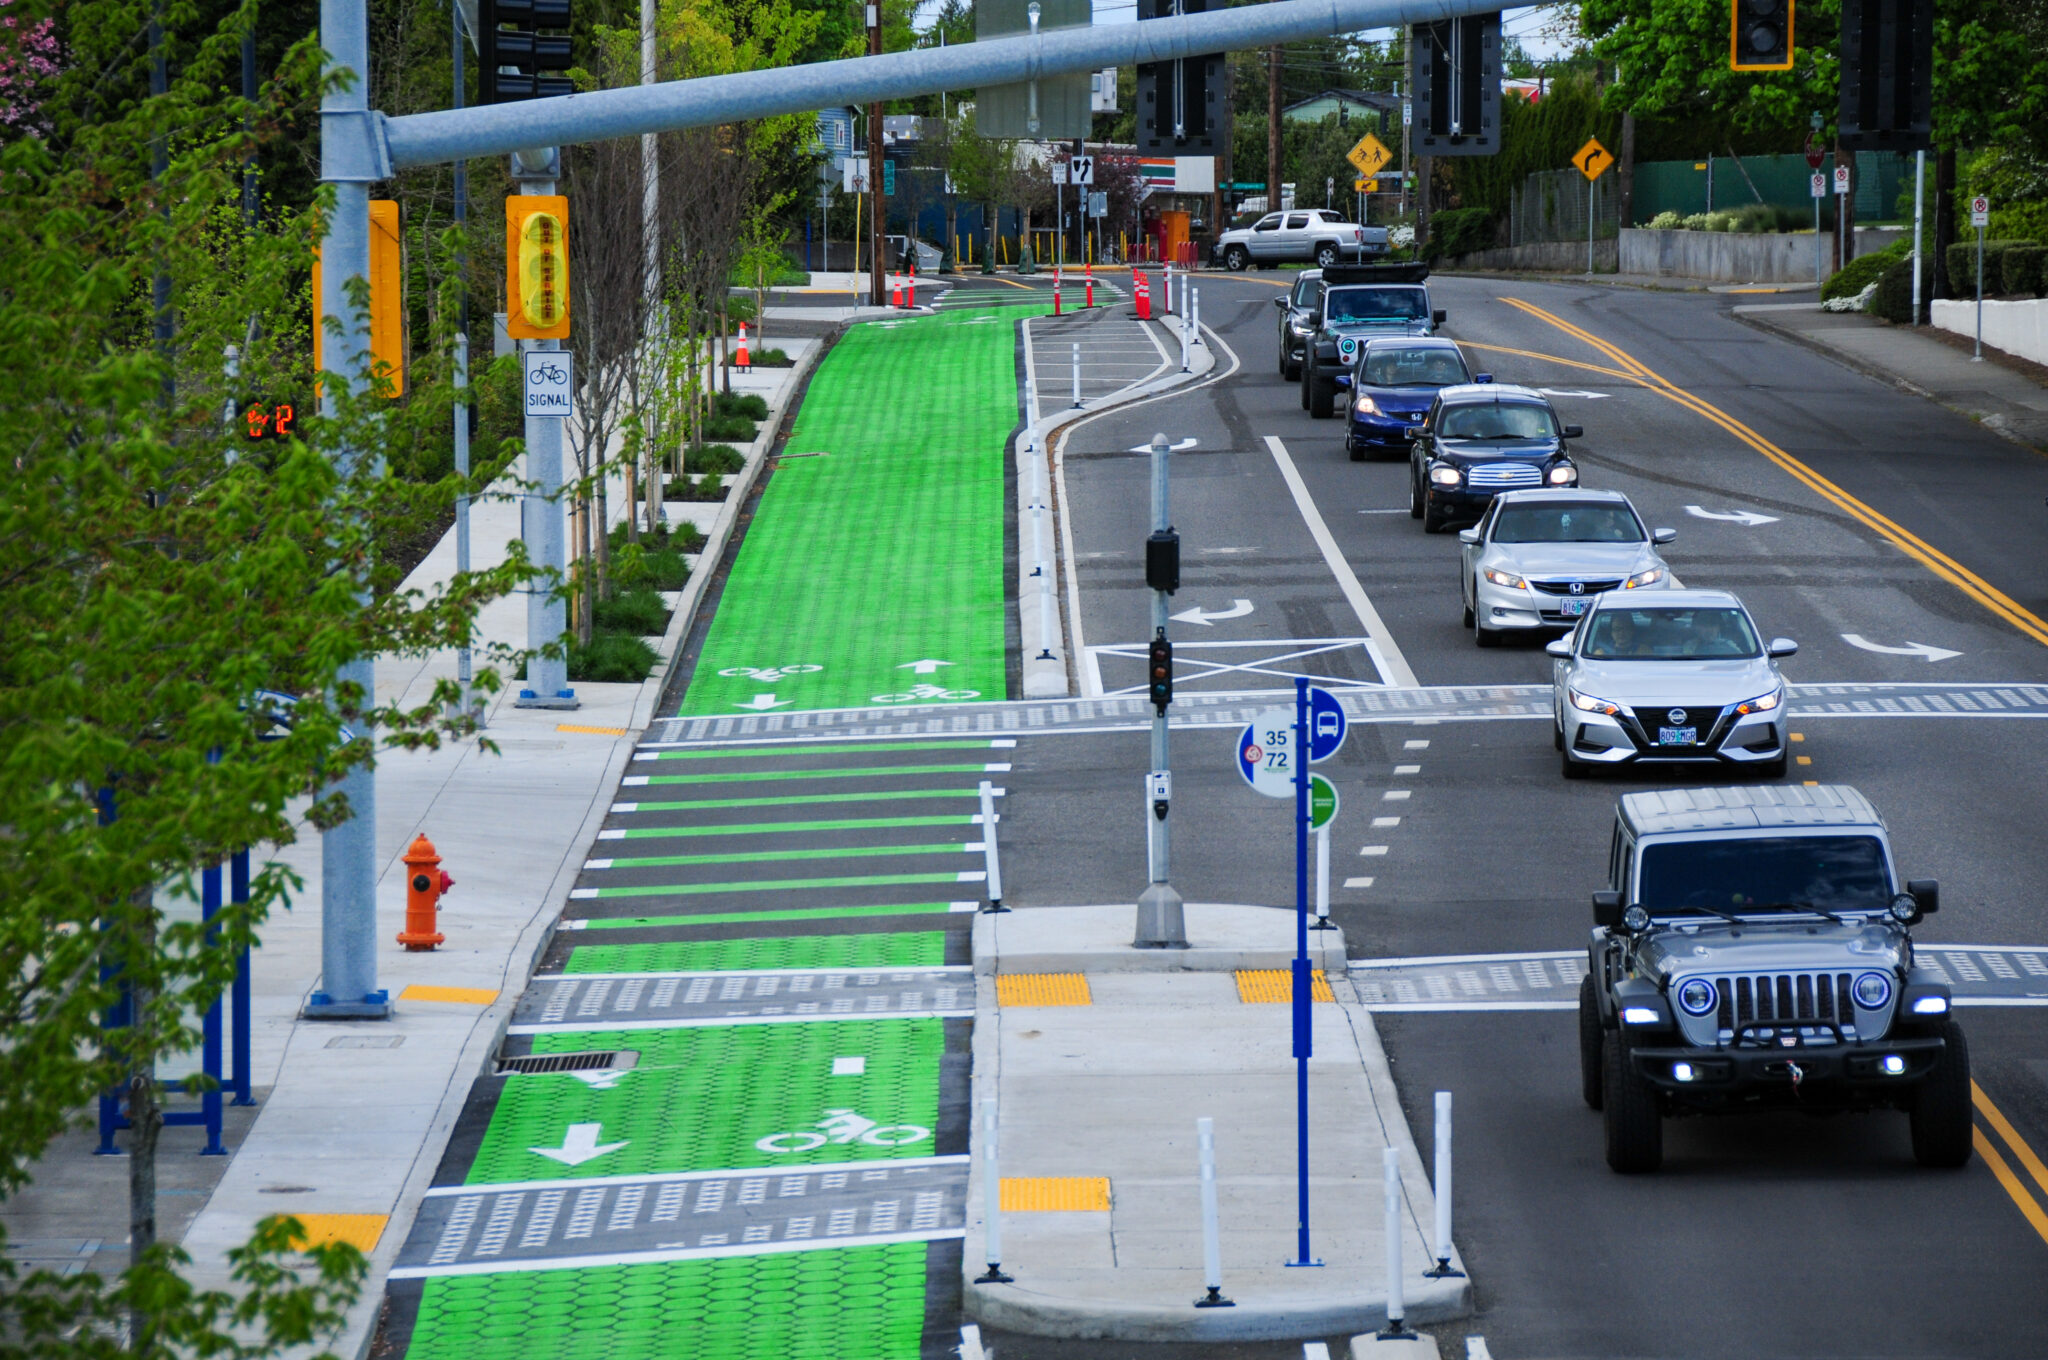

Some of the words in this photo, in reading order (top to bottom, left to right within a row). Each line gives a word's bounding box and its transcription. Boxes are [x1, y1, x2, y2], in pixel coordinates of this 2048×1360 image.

[543, 268, 552, 318] SERVICE
[529, 394, 569, 406] SIGNAL
[1266, 730, 1287, 745] 35
[1660, 731, 1676, 742] 809
[1680, 731, 1696, 742] MGR
[1266, 752, 1287, 767] 72
